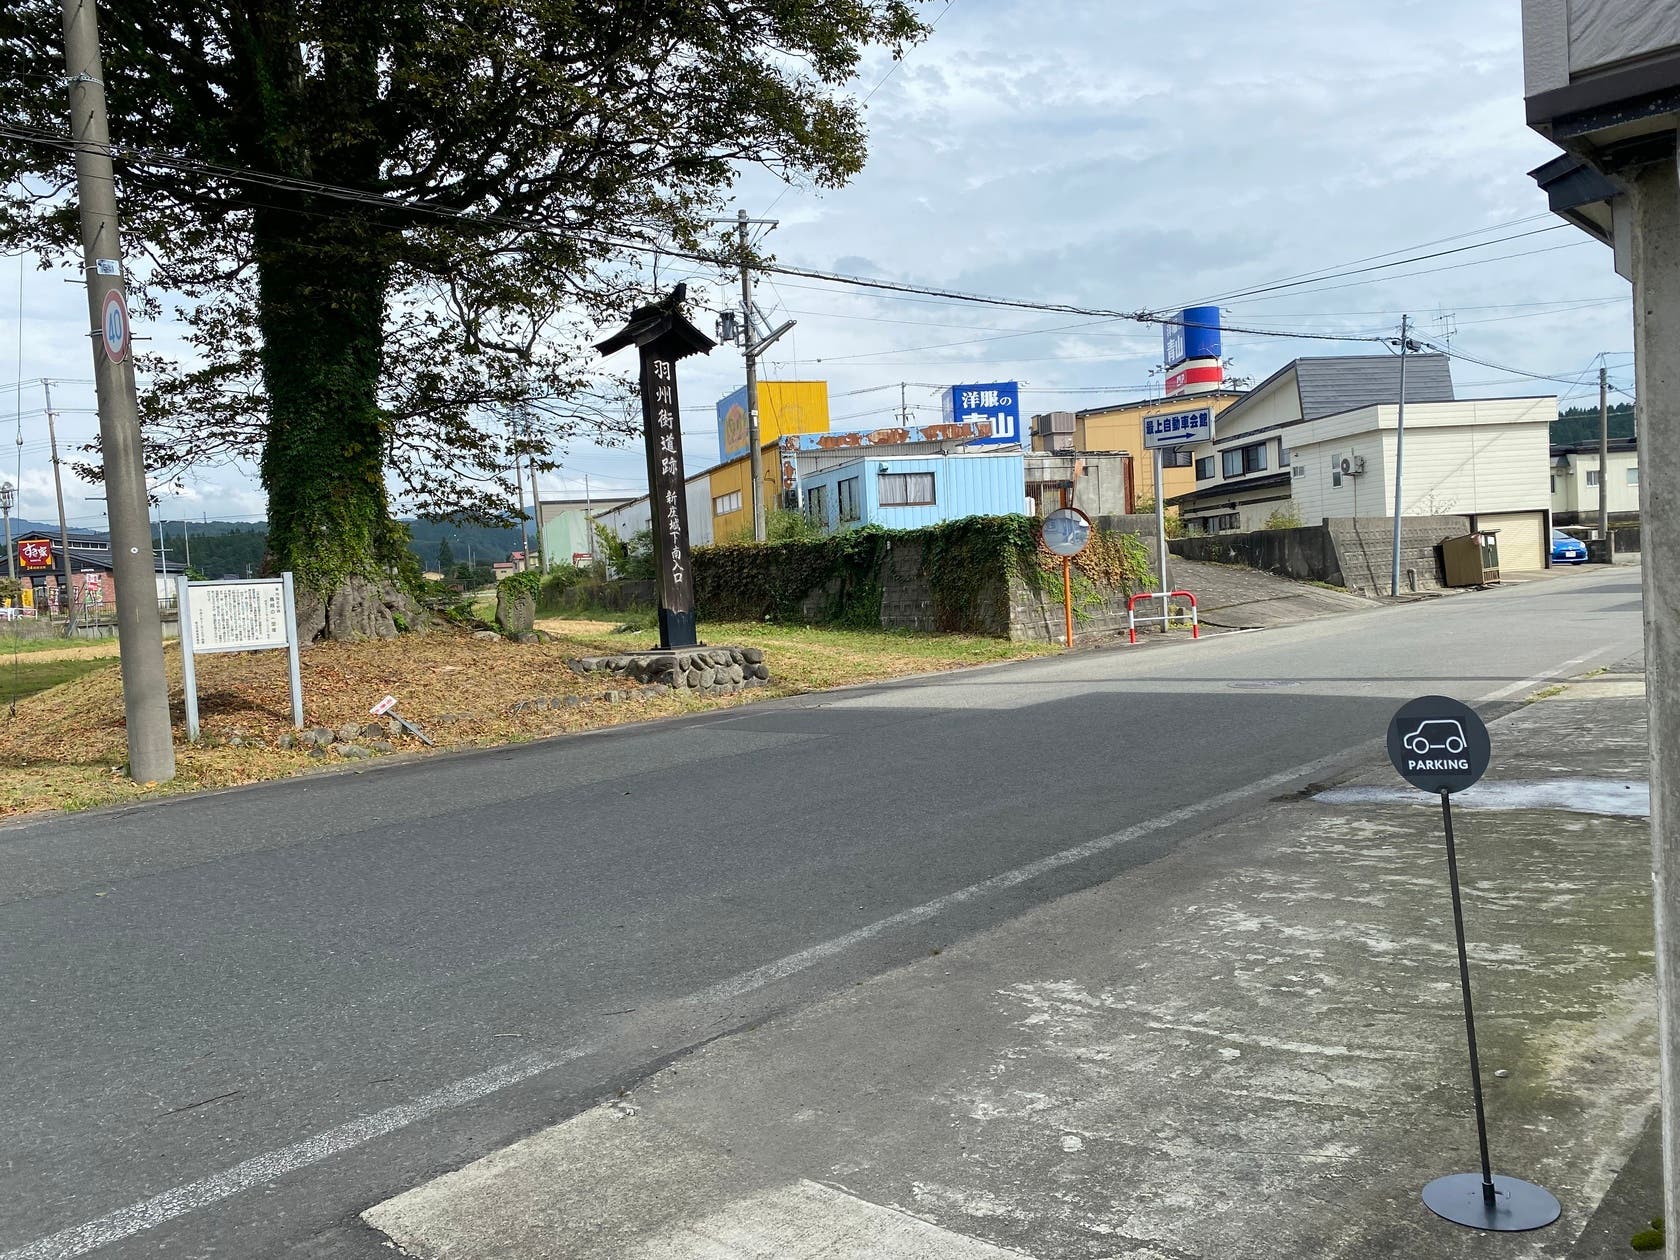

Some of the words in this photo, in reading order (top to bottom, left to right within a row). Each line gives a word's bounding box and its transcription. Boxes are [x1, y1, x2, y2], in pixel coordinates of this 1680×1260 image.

[108, 308, 122, 343] 40
[961, 390, 1012, 409] 洋服の
[653, 359, 678, 476] 羽州街道跡
[1146, 412, 1208, 435] 最上自動車会館
[664, 489, 685, 584] 新庄城下南入口
[22, 543, 48, 560] すき家
[1408, 759, 1469, 770] PARKING
